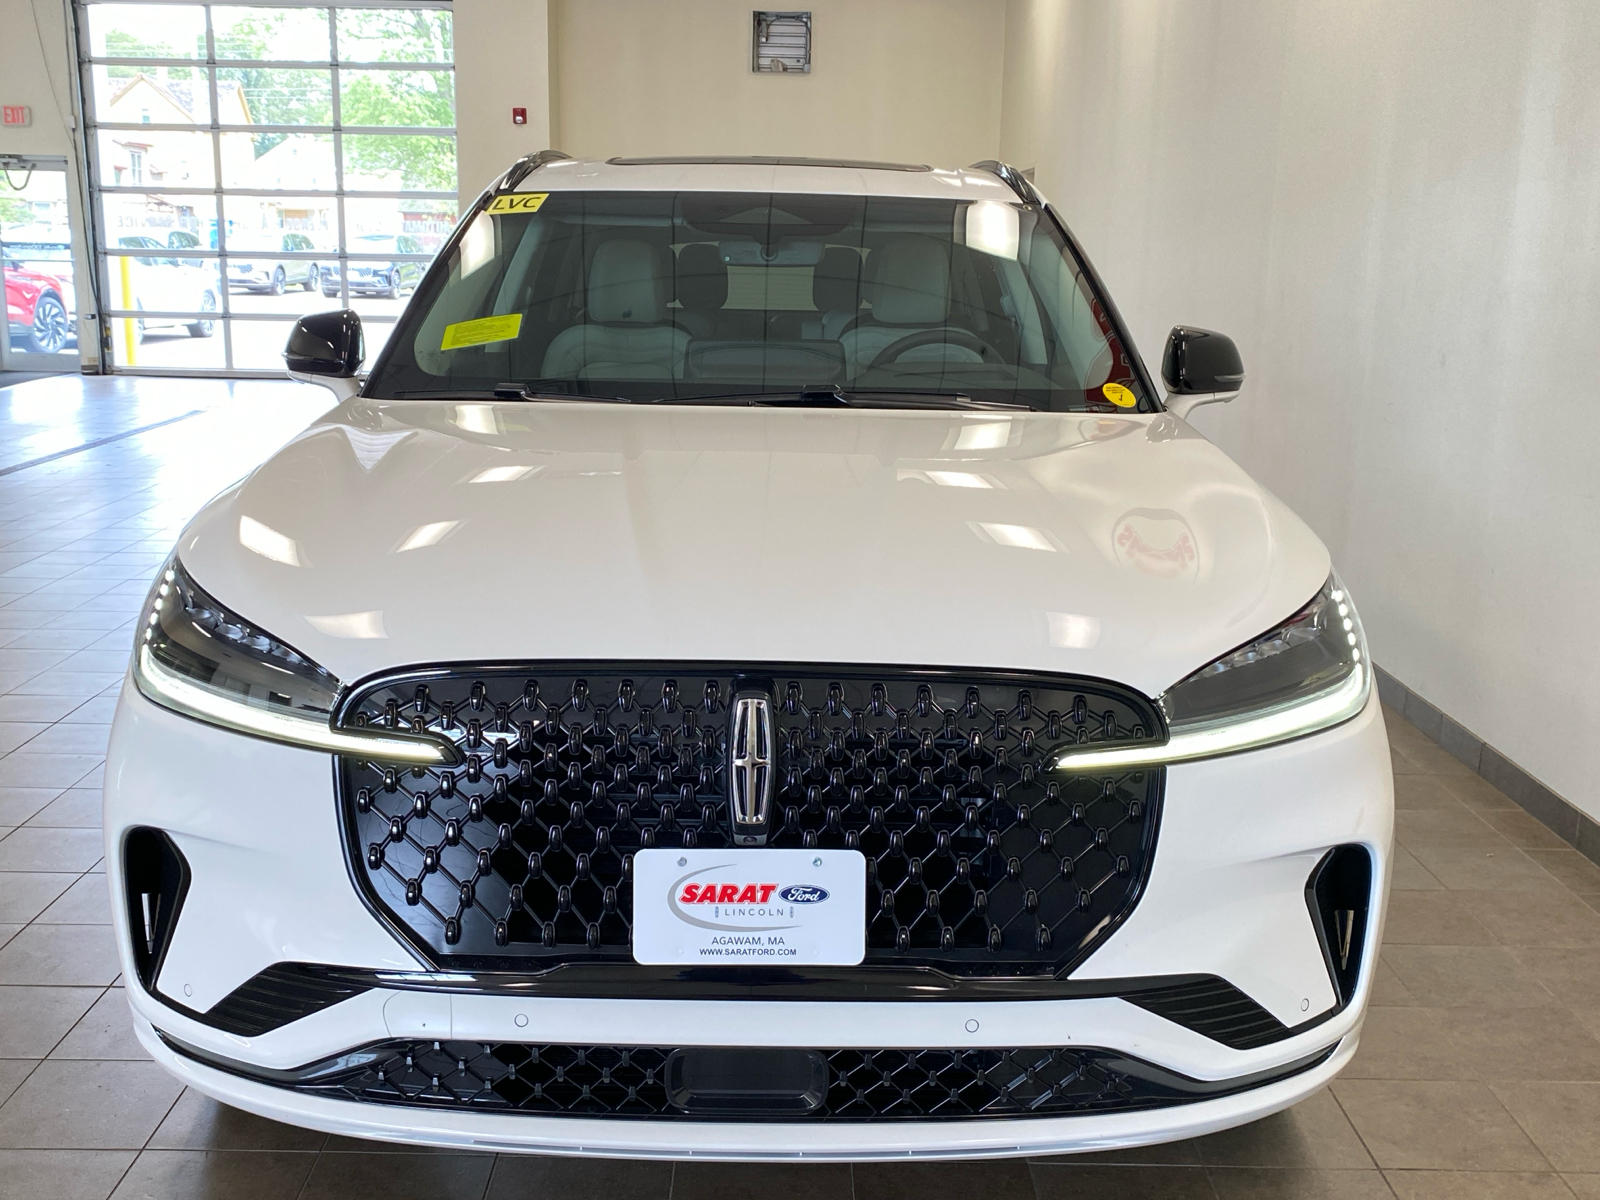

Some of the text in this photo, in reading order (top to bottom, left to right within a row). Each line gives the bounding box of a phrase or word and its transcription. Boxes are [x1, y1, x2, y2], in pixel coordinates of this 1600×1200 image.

[3, 106, 25, 124] EXIT
[492, 197, 541, 210] LVC
[678, 882, 820, 905] SARAT Ford
[724, 908, 784, 917] LINCOLN
[711, 936, 785, 947] AGAWAM, MA
[699, 948, 797, 956] WWW.SARATFORD.COM
